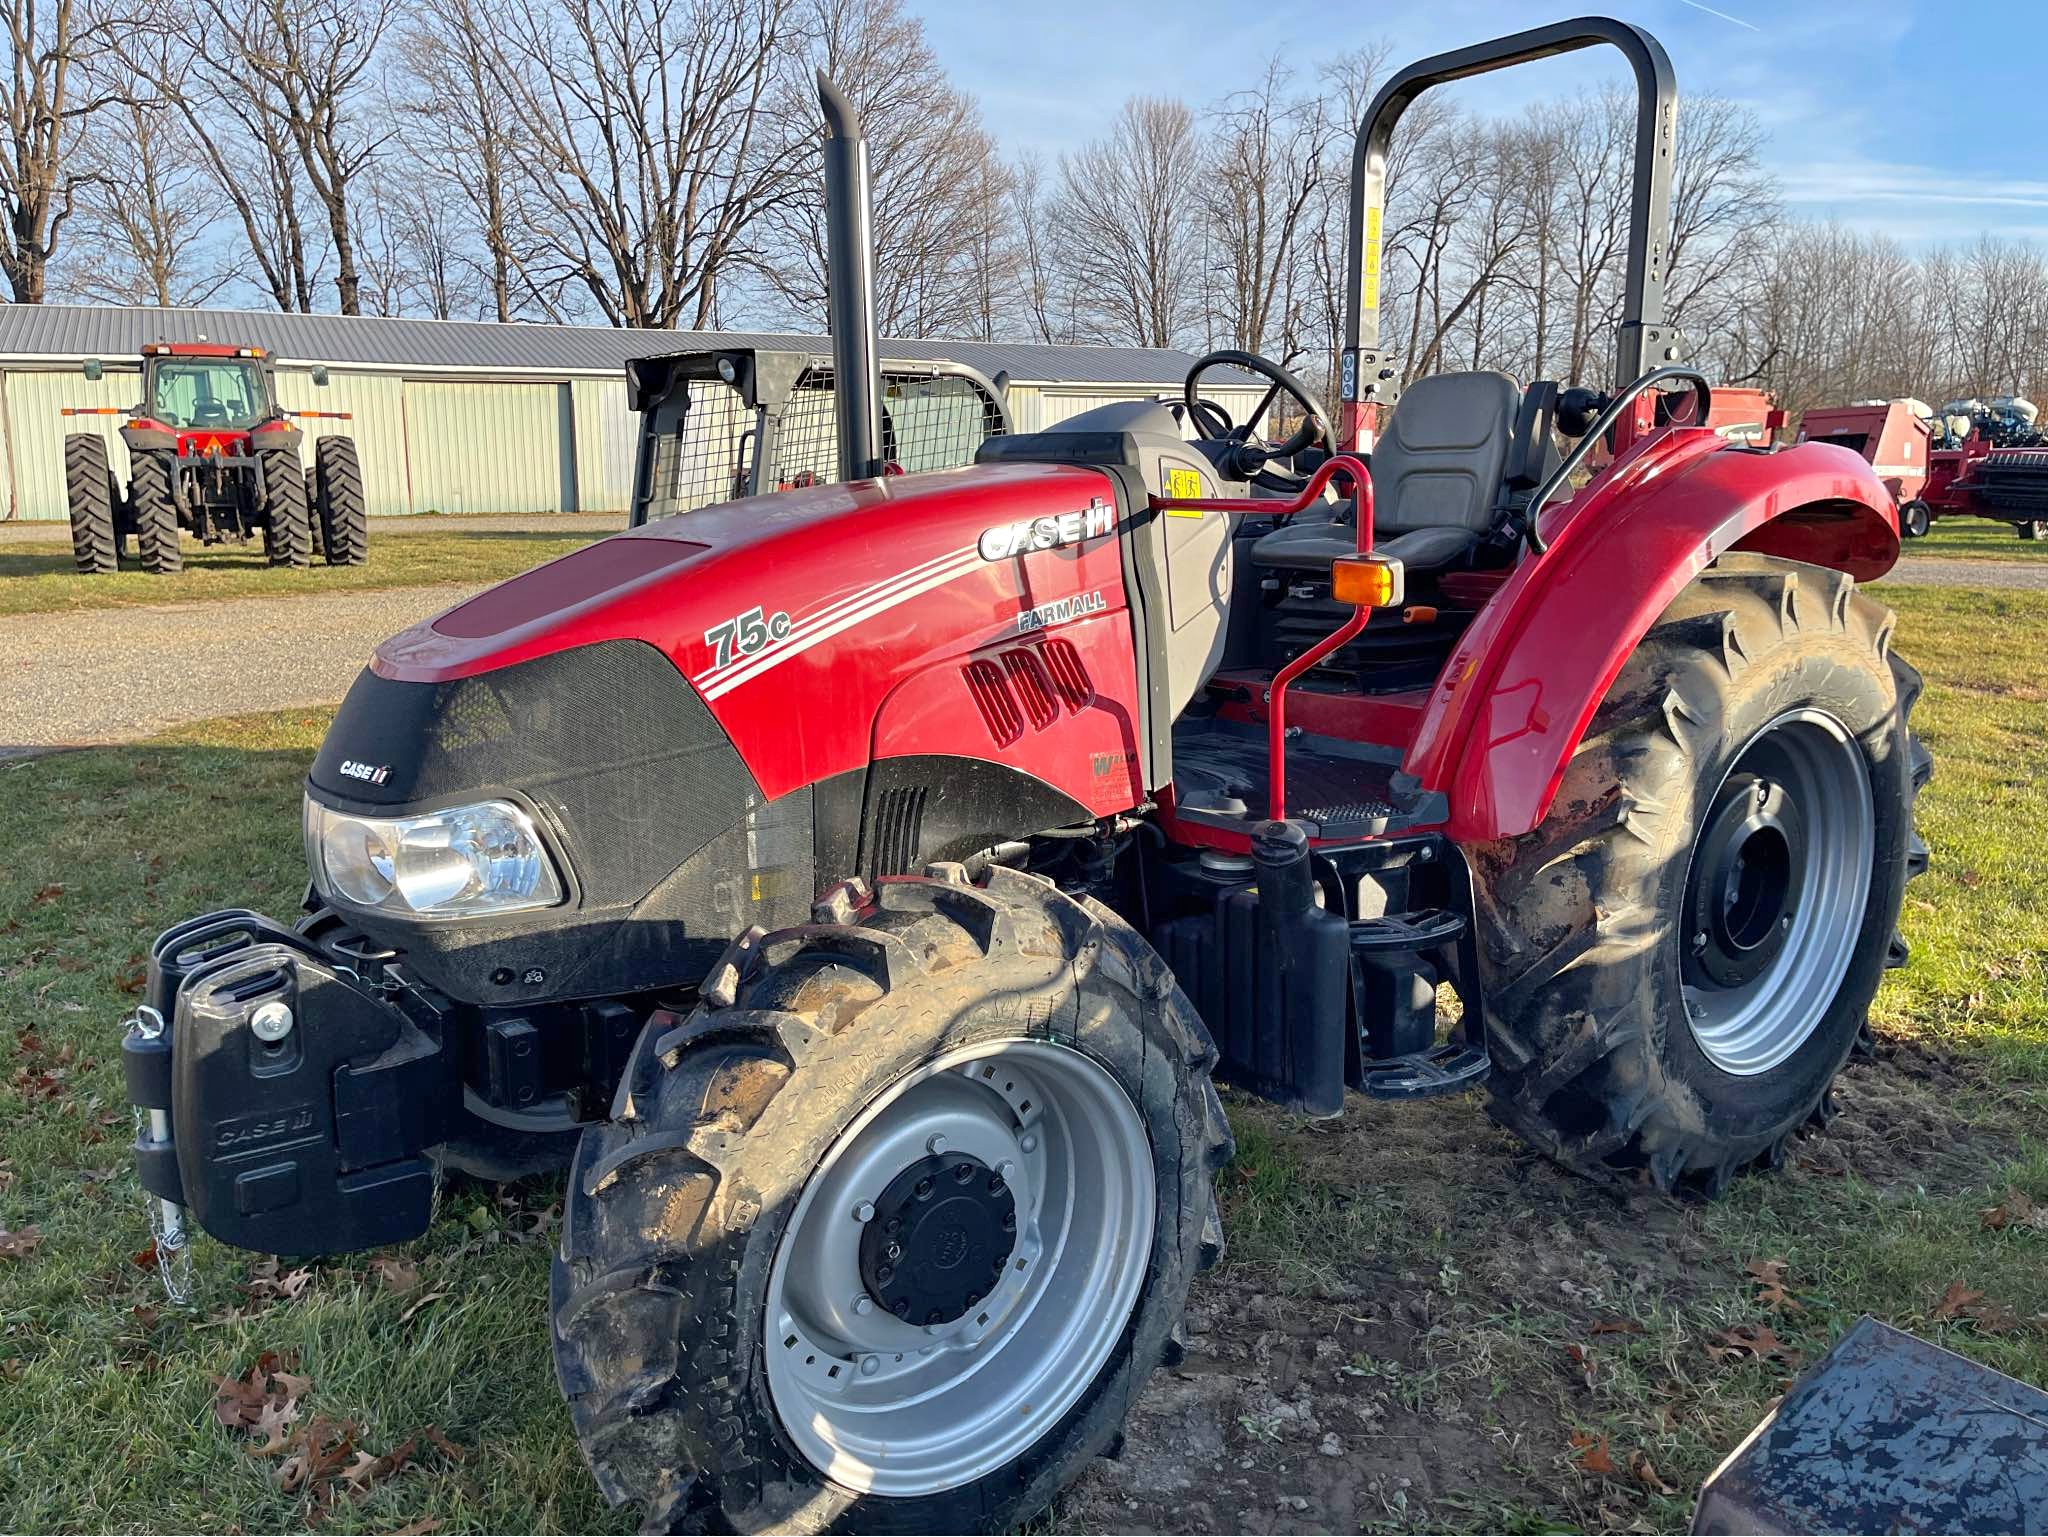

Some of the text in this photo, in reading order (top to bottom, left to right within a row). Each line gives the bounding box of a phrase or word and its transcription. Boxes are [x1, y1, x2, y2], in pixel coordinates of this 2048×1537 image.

[978, 511, 1081, 562] CASE
[1018, 591, 1107, 632] FARMALL
[340, 760, 374, 781] CASE
[217, 1119, 288, 1147] CASE
